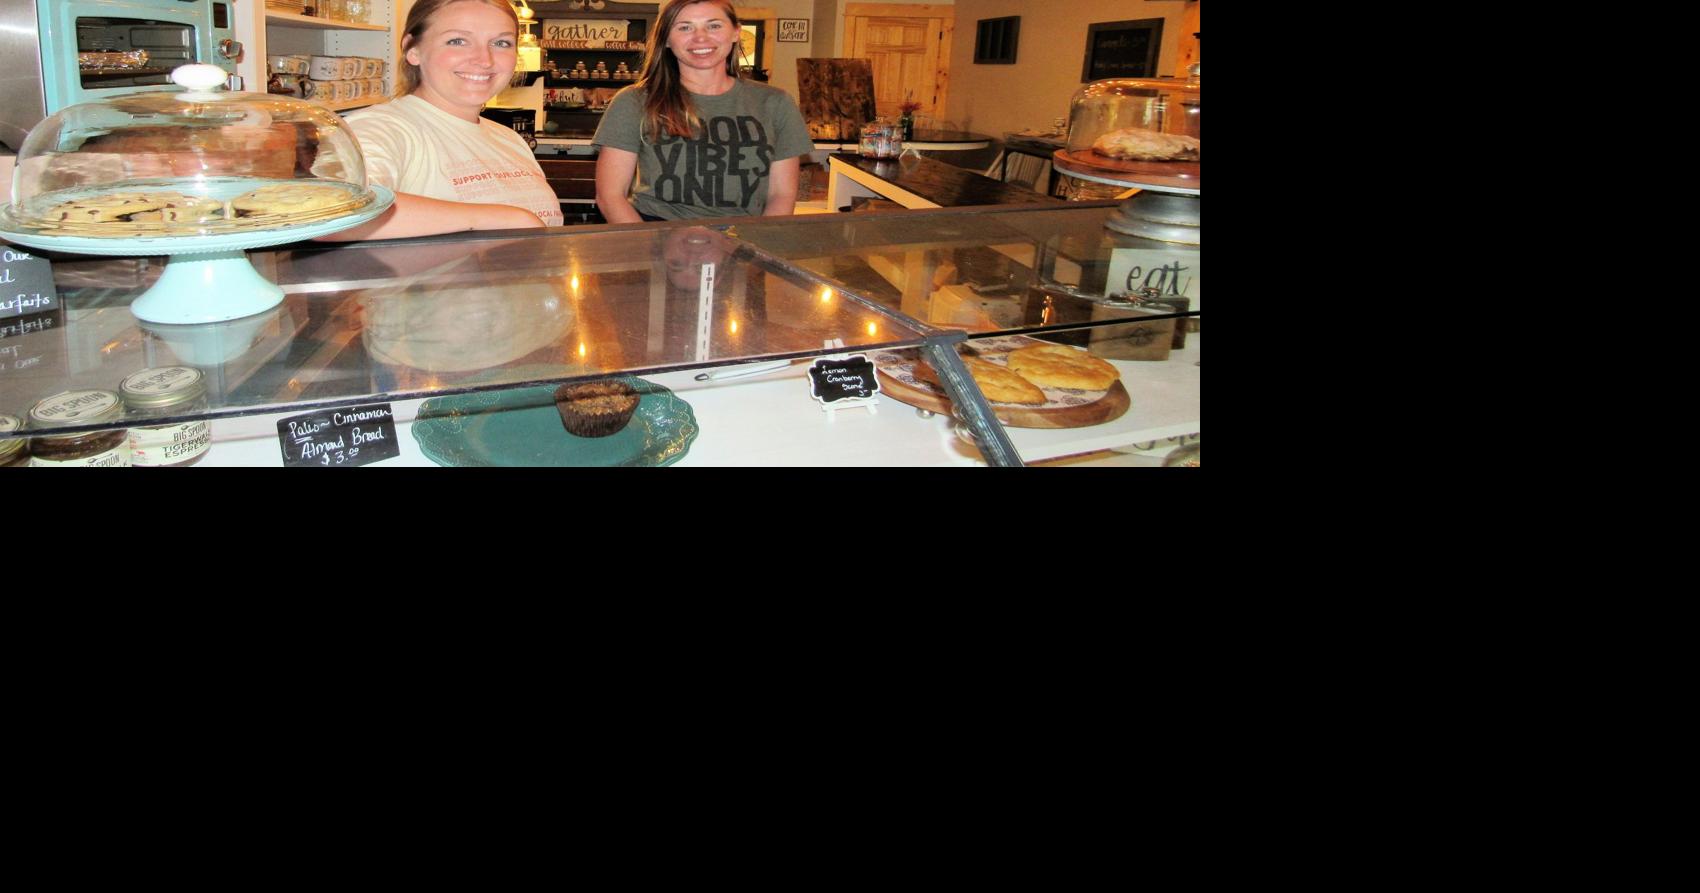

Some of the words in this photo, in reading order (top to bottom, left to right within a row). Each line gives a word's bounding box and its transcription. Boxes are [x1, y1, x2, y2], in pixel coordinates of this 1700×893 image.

[548, 23, 623, 40] gather
[653, 143, 776, 177] VIBES
[452, 172, 492, 186] SUPPORT
[654, 174, 760, 208] ONLY
[1126, 260, 1191, 297] eat
[0, 293, 50, 314] arfaits
[826, 374, 864, 385] Cranberry
[67, 391, 107, 409] SPOON
[173, 431, 187, 442] BIG
[301, 435, 345, 459] Almond
[351, 426, 385, 446] Bread
